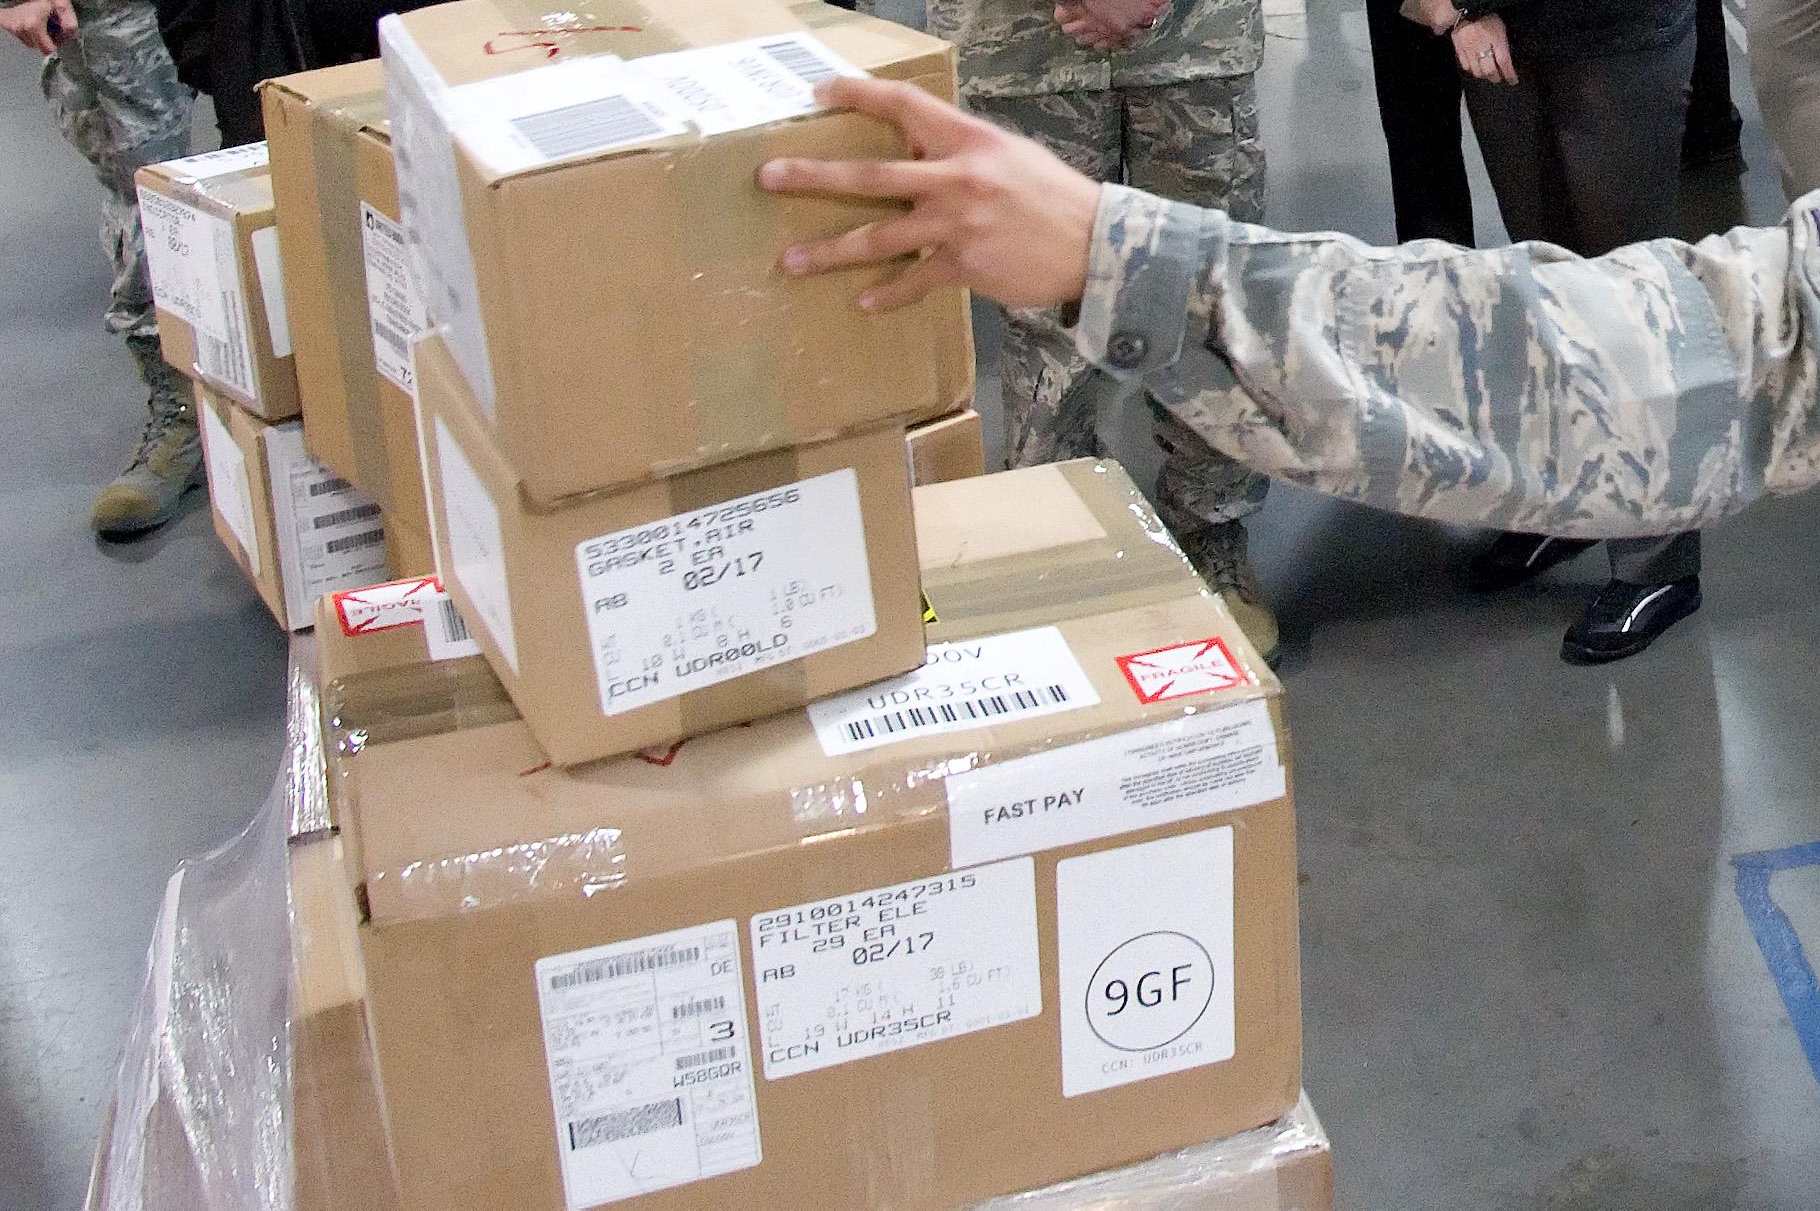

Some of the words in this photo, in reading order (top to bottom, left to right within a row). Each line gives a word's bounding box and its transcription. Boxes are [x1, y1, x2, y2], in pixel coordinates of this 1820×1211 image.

[585, 488, 801, 561] 5330014725656
[658, 559, 675, 576] 2
[691, 545, 725, 567] EA
[594, 592, 629, 614] AB
[682, 551, 765, 591] 02/17
[352, 598, 422, 617] RAGILE
[608, 671, 659, 697] CCN
[1140, 657, 1223, 682] FRAGILE
[867, 672, 1025, 710] UDR35CR
[983, 798, 1039, 825] FAST
[1043, 787, 1086, 811] PAY
[758, 874, 977, 932] 2910014247315
[760, 915, 861, 948] FILTER
[878, 901, 928, 922] ELE
[812, 937, 846, 953] 29
[863, 925, 896, 942] EA
[710, 959, 735, 977] DE
[762, 964, 796, 983] AB
[852, 931, 935, 966] 02/17
[1104, 963, 1194, 1017] 9GF
[709, 1020, 736, 1042] 3
[769, 1040, 820, 1064] CCN
[836, 1010, 952, 1049] UDR35CR
[1142, 1042, 1204, 1065] UDR35CR
